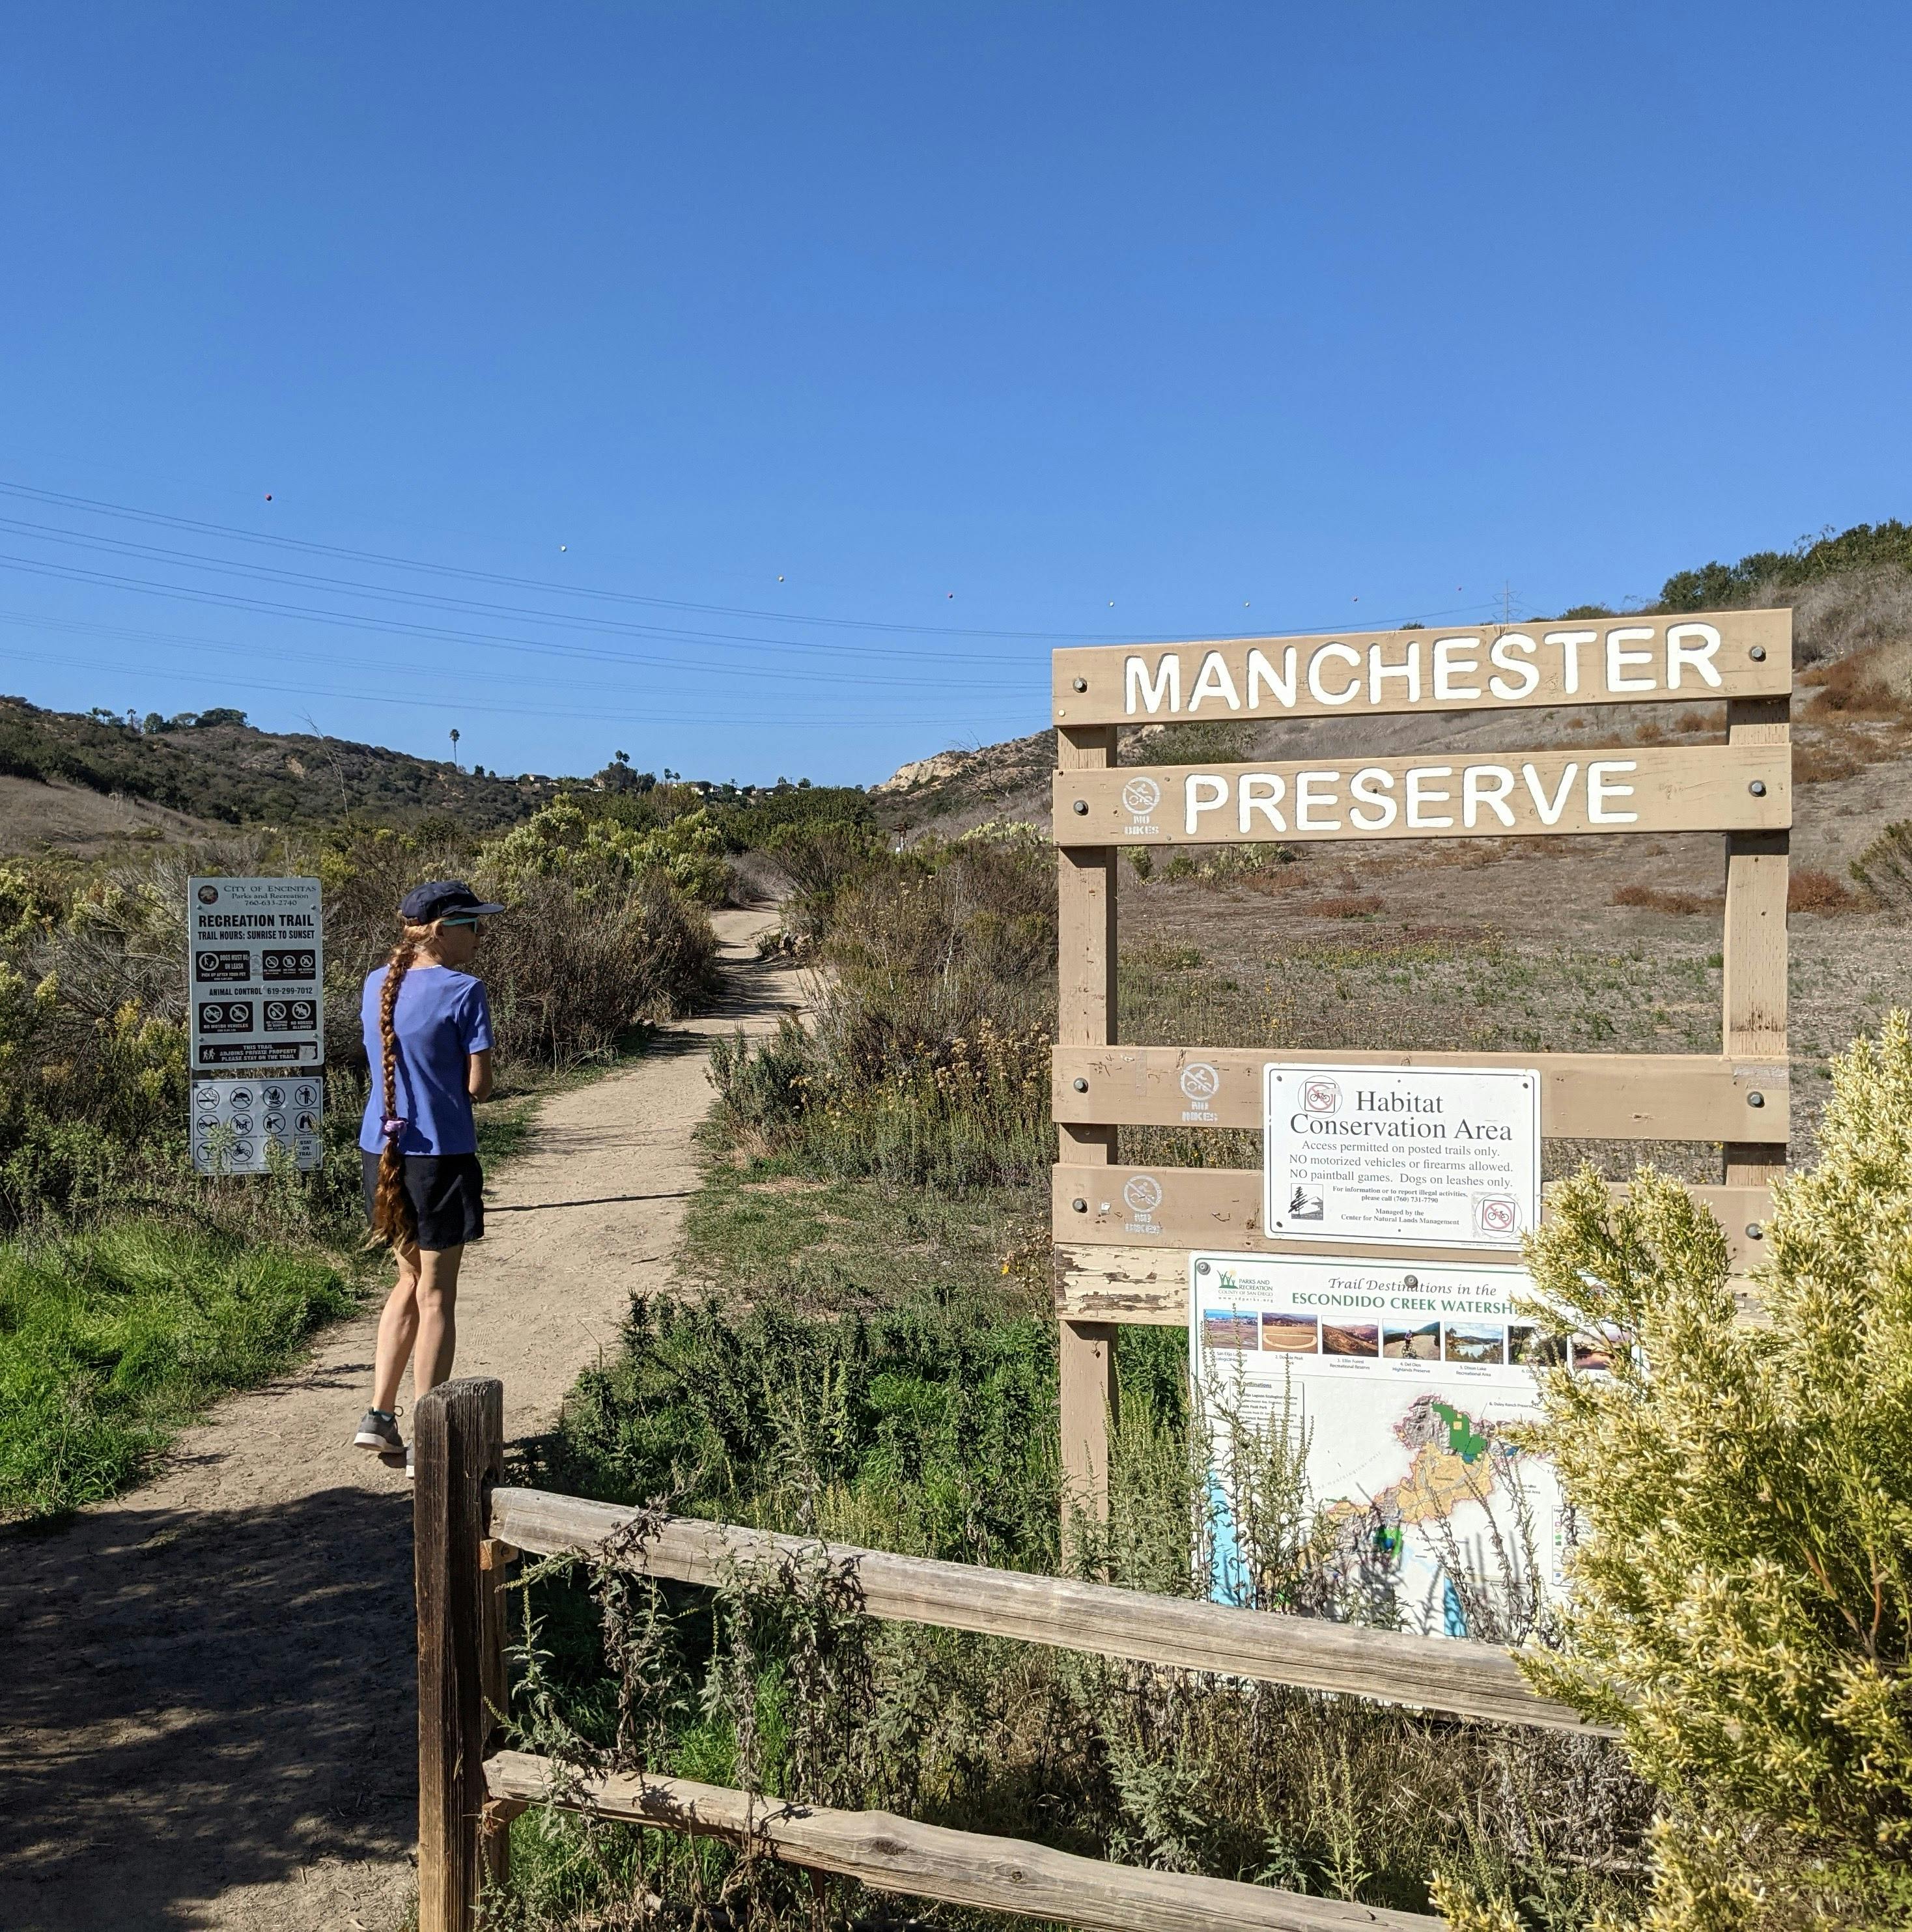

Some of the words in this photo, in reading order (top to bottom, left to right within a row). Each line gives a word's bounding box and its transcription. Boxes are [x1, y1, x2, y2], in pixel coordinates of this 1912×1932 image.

[1125, 622, 1722, 715] MANCHESTER
[1185, 760, 1638, 834] PRESERVE
[1133, 815, 1149, 824] NO
[1124, 826, 1159, 835] BIKES
[199, 915, 275, 927] RECREATION
[279, 914, 315, 927] TRAIL
[198, 931, 218, 940] TRAIL
[219, 931, 246, 940] HOURS:
[247, 931, 277, 940] SUNRISE
[278, 931, 287, 939] TO
[289, 930, 315, 939] SUNSET
[209, 988, 232, 996] ANIMAL
[1356, 1091, 1444, 1113] Habitat
[1291, 1113, 1447, 1138] Conservation
[1454, 1119, 1513, 1140] Area
[1302, 1141, 1337, 1151] Access
[1340, 1142, 1388, 1153] permitted
[1408, 1145, 1442, 1155] posted
[1445, 1145, 1471, 1155] trails
[1474, 1147, 1500, 1158] only.
[1289, 1154, 1307, 1164] NO
[1310, 1156, 1361, 1166] motorized
[1364, 1158, 1406, 1168] vehicles
[1424, 1160, 1466, 1170] firearms
[1469, 1162, 1513, 1172] allowed.
[1290, 1169, 1308, 1179] NO
[1311, 1170, 1354, 1182] paintball
[1358, 1175, 1393, 1183] games.
[1400, 1173, 1427, 1186] Dogs
[1446, 1175, 1484, 1186] leashes
[1487, 1177, 1513, 1190] only.
[1329, 1277, 1366, 1290] Trail
[1457, 1283, 1472, 1295] in
[1475, 1283, 1497, 1296] the
[1292, 1293, 1385, 1308] ESCONDIDO
[1390, 1297, 1437, 1311] CREEK
